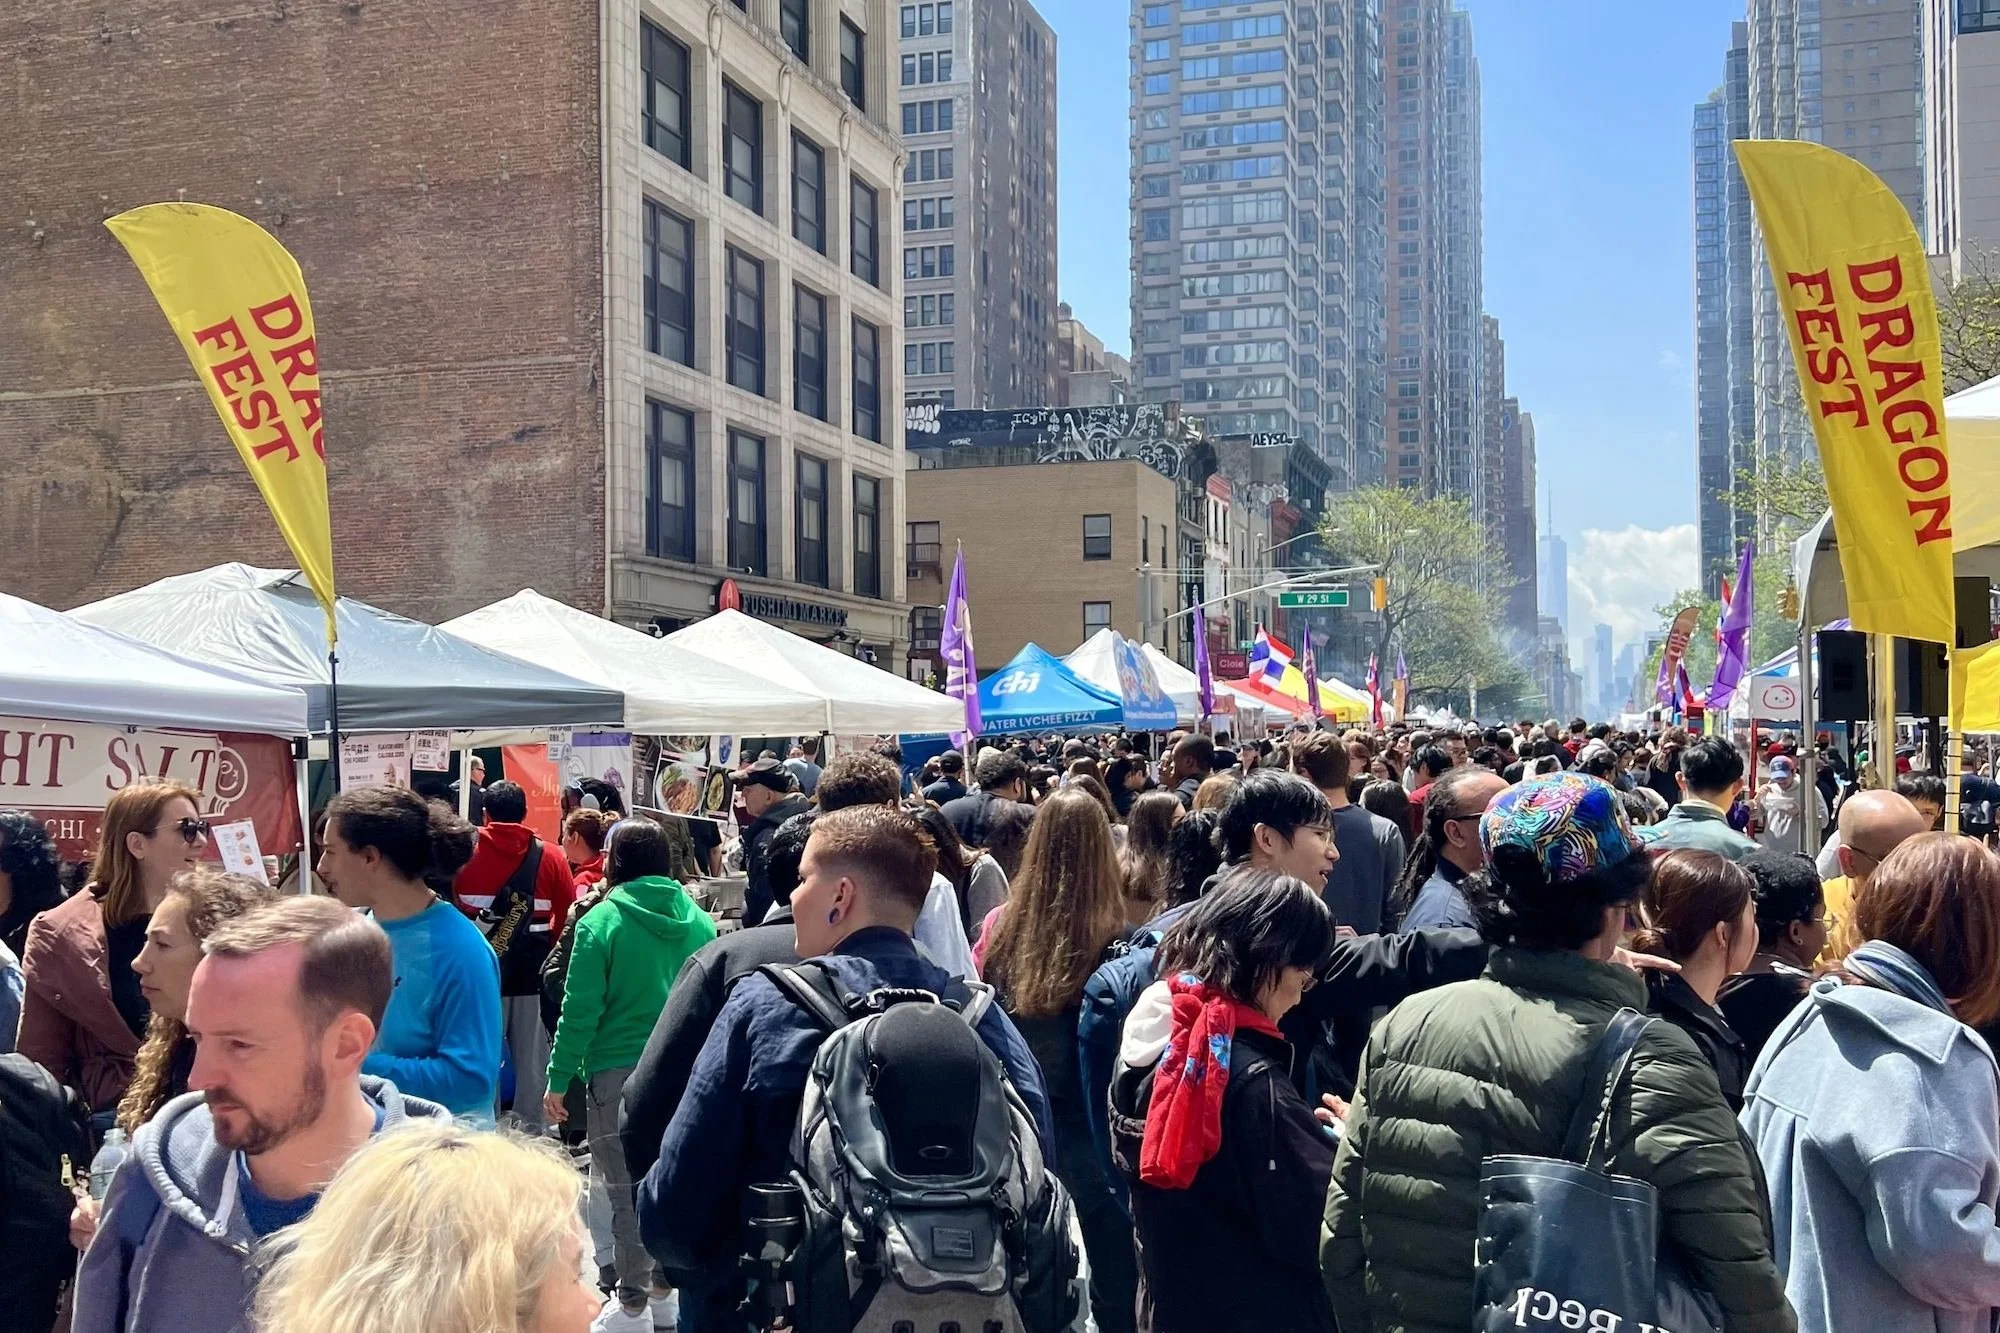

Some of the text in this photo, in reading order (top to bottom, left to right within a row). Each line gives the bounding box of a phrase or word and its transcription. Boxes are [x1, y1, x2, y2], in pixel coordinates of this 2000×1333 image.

[192, 315, 299, 464] FEST
[1786, 268, 1870, 429] FEST
[1848, 254, 1952, 547] DRAGON
[743, 595, 849, 626] FUSHIMI MARKET
[1297, 594, 1329, 603] W 29 St
[1020, 714, 1063, 728] LYCHEE
[1065, 711, 1097, 723] FIZZY
